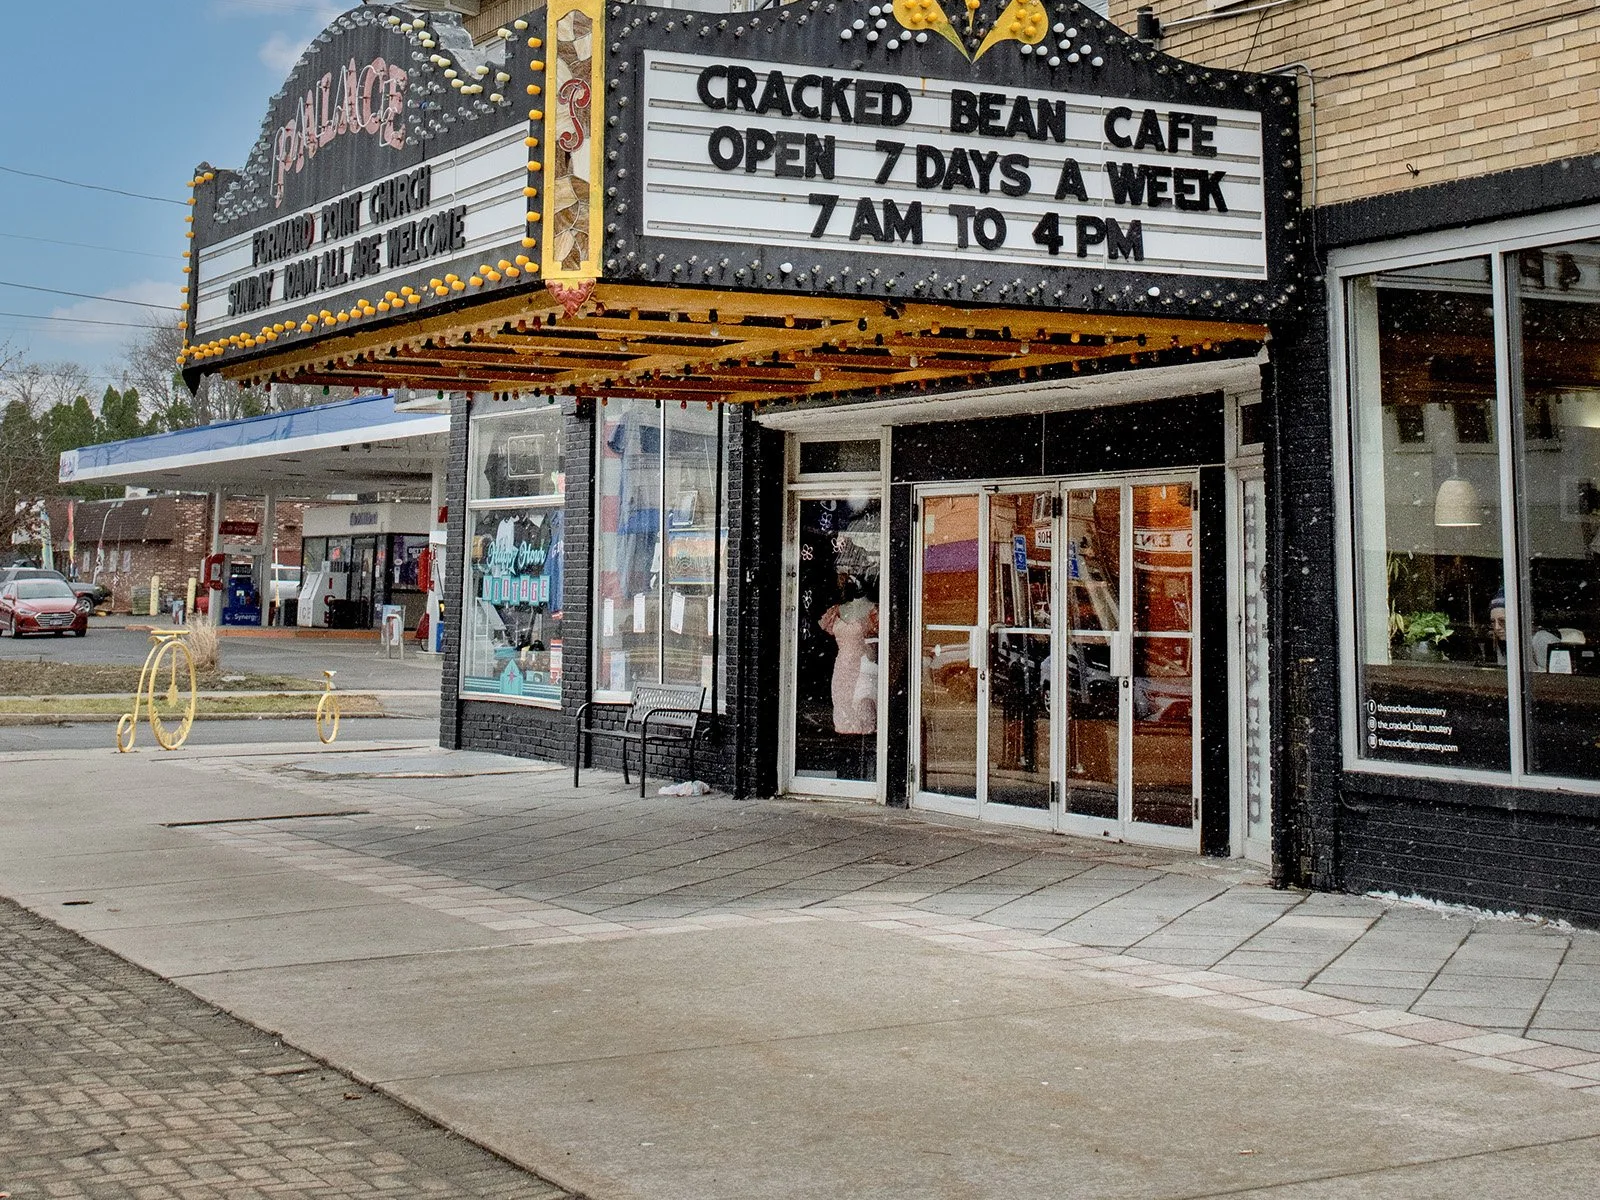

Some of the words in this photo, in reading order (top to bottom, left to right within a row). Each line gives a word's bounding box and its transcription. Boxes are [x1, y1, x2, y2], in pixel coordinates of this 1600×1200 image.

[270, 56, 408, 208] PALACE
[697, 65, 912, 126] CRACKED
[950, 89, 1066, 143] BEAN
[1103, 106, 1218, 157] CAFE
[707, 126, 835, 180] OPEN
[874, 139, 905, 184] 7
[916, 143, 1032, 198] DAYS
[1055, 157, 1088, 202] A
[1106, 161, 1227, 213] WEEK
[252, 212, 315, 267] FORWARD
[321, 191, 362, 243] POINT
[369, 164, 431, 224] CHURCH
[808, 193, 839, 238] 7
[850, 197, 923, 245] AM
[948, 203, 1007, 250] TO
[1032, 211, 1064, 256] 4
[1076, 214, 1145, 261] PM
[227, 269, 274, 316] SUNDAY
[320, 247, 348, 289] ALL
[350, 233, 382, 281] ARE
[386, 205, 467, 269] WELCOME
[484, 577, 549, 603] VINTAGE
[487, 541, 519, 575] Happy
[518, 541, 546, 569] Hour
[234, 613, 258, 622] Synergy
